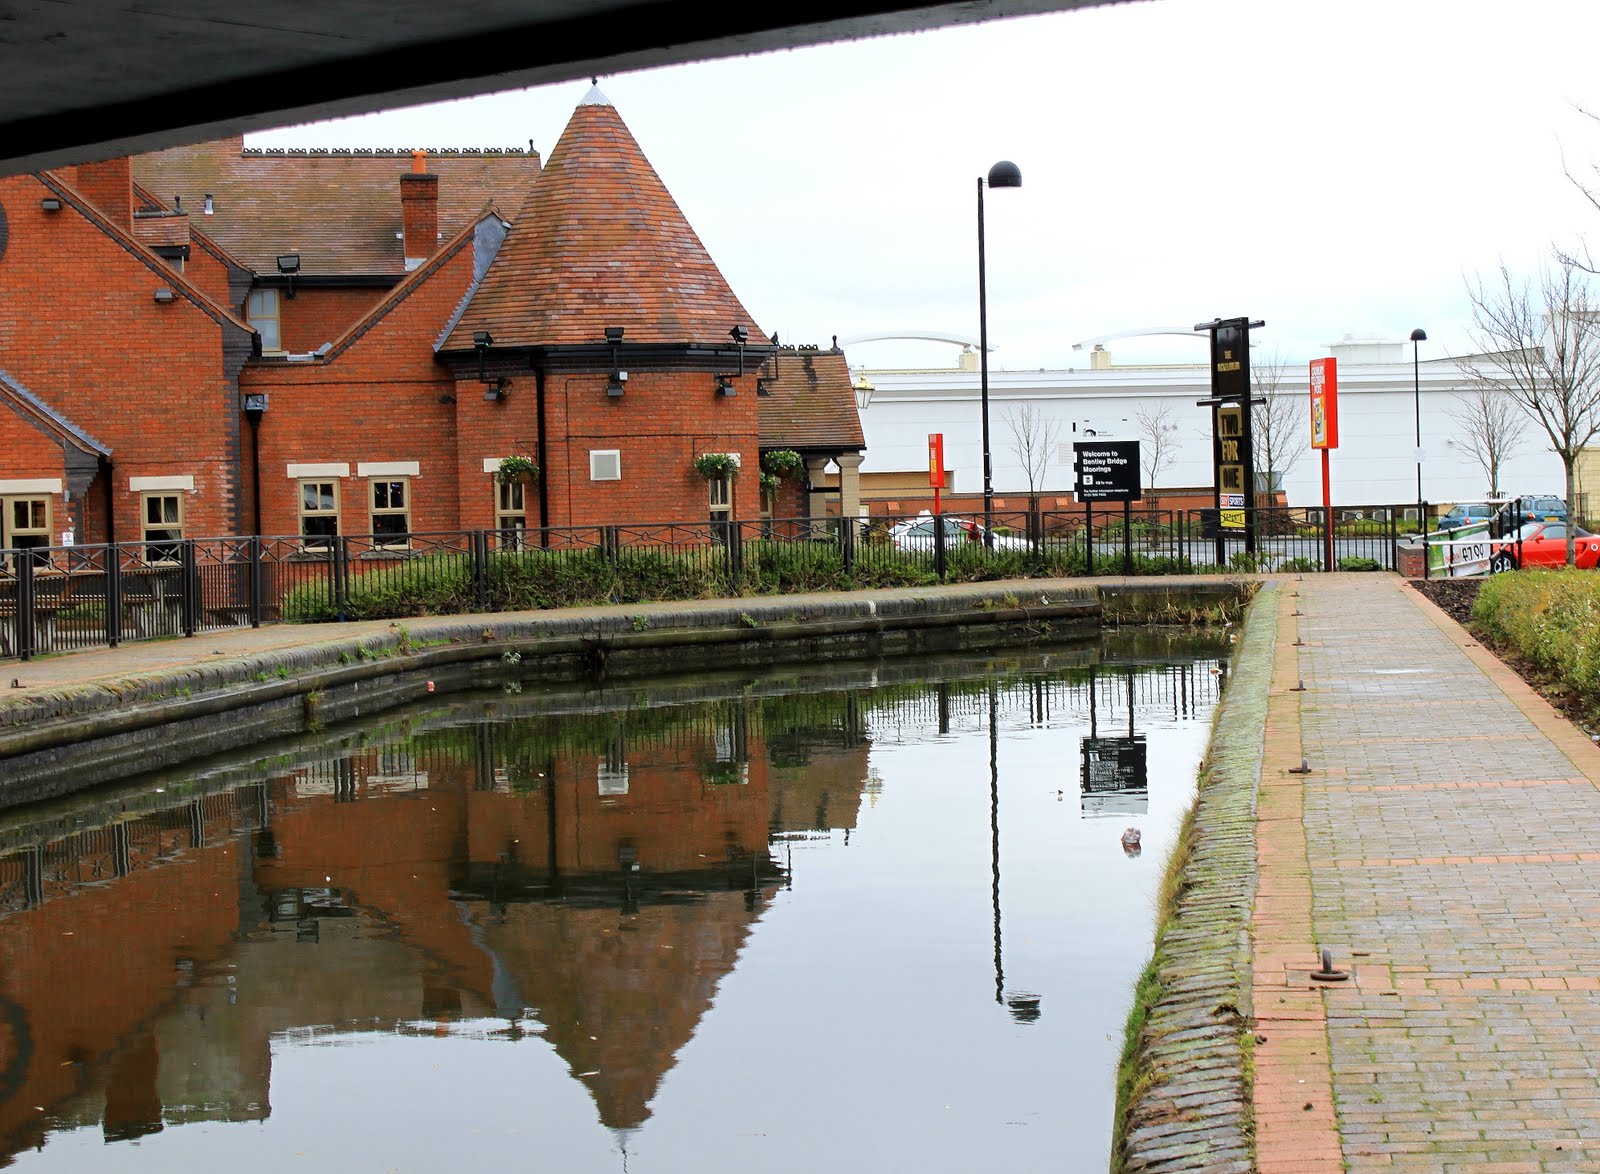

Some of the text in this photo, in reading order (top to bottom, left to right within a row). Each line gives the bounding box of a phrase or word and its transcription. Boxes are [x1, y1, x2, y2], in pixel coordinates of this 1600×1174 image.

[1221, 414, 1238, 435] TWO
[1222, 440, 1238, 461] FOR
[1082, 457, 1127, 466] Bentley Bridge
[1223, 467, 1240, 489] ONE
[1229, 496, 1244, 506] SPORTS
[1462, 544, 1484, 562] £799
